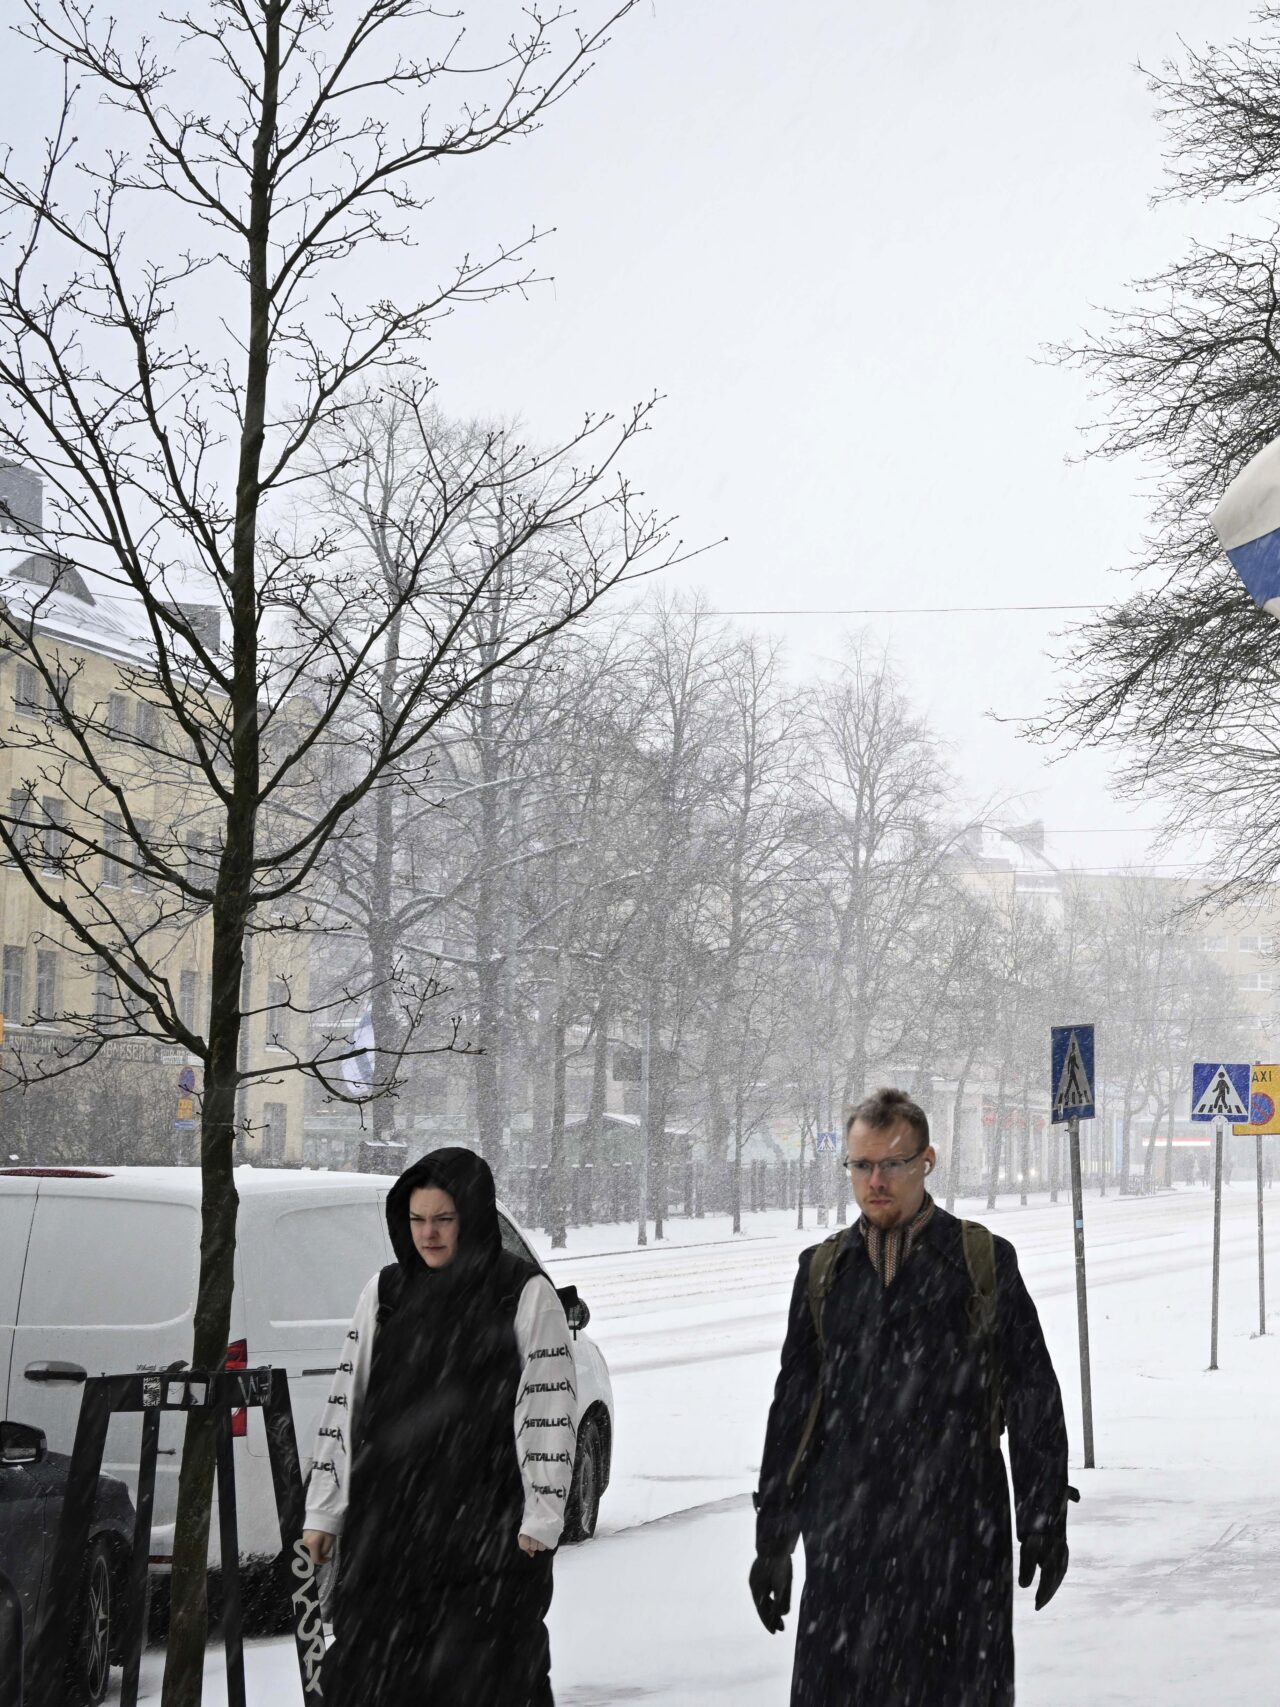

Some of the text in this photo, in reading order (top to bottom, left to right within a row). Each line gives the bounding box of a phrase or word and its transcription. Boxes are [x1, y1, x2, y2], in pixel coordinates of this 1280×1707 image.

[1251, 1070, 1272, 1082] AXI
[515, 1377, 577, 1408] METALLICA
[516, 1413, 577, 1440] METALLICA
[522, 1448, 574, 1469] METALLICA
